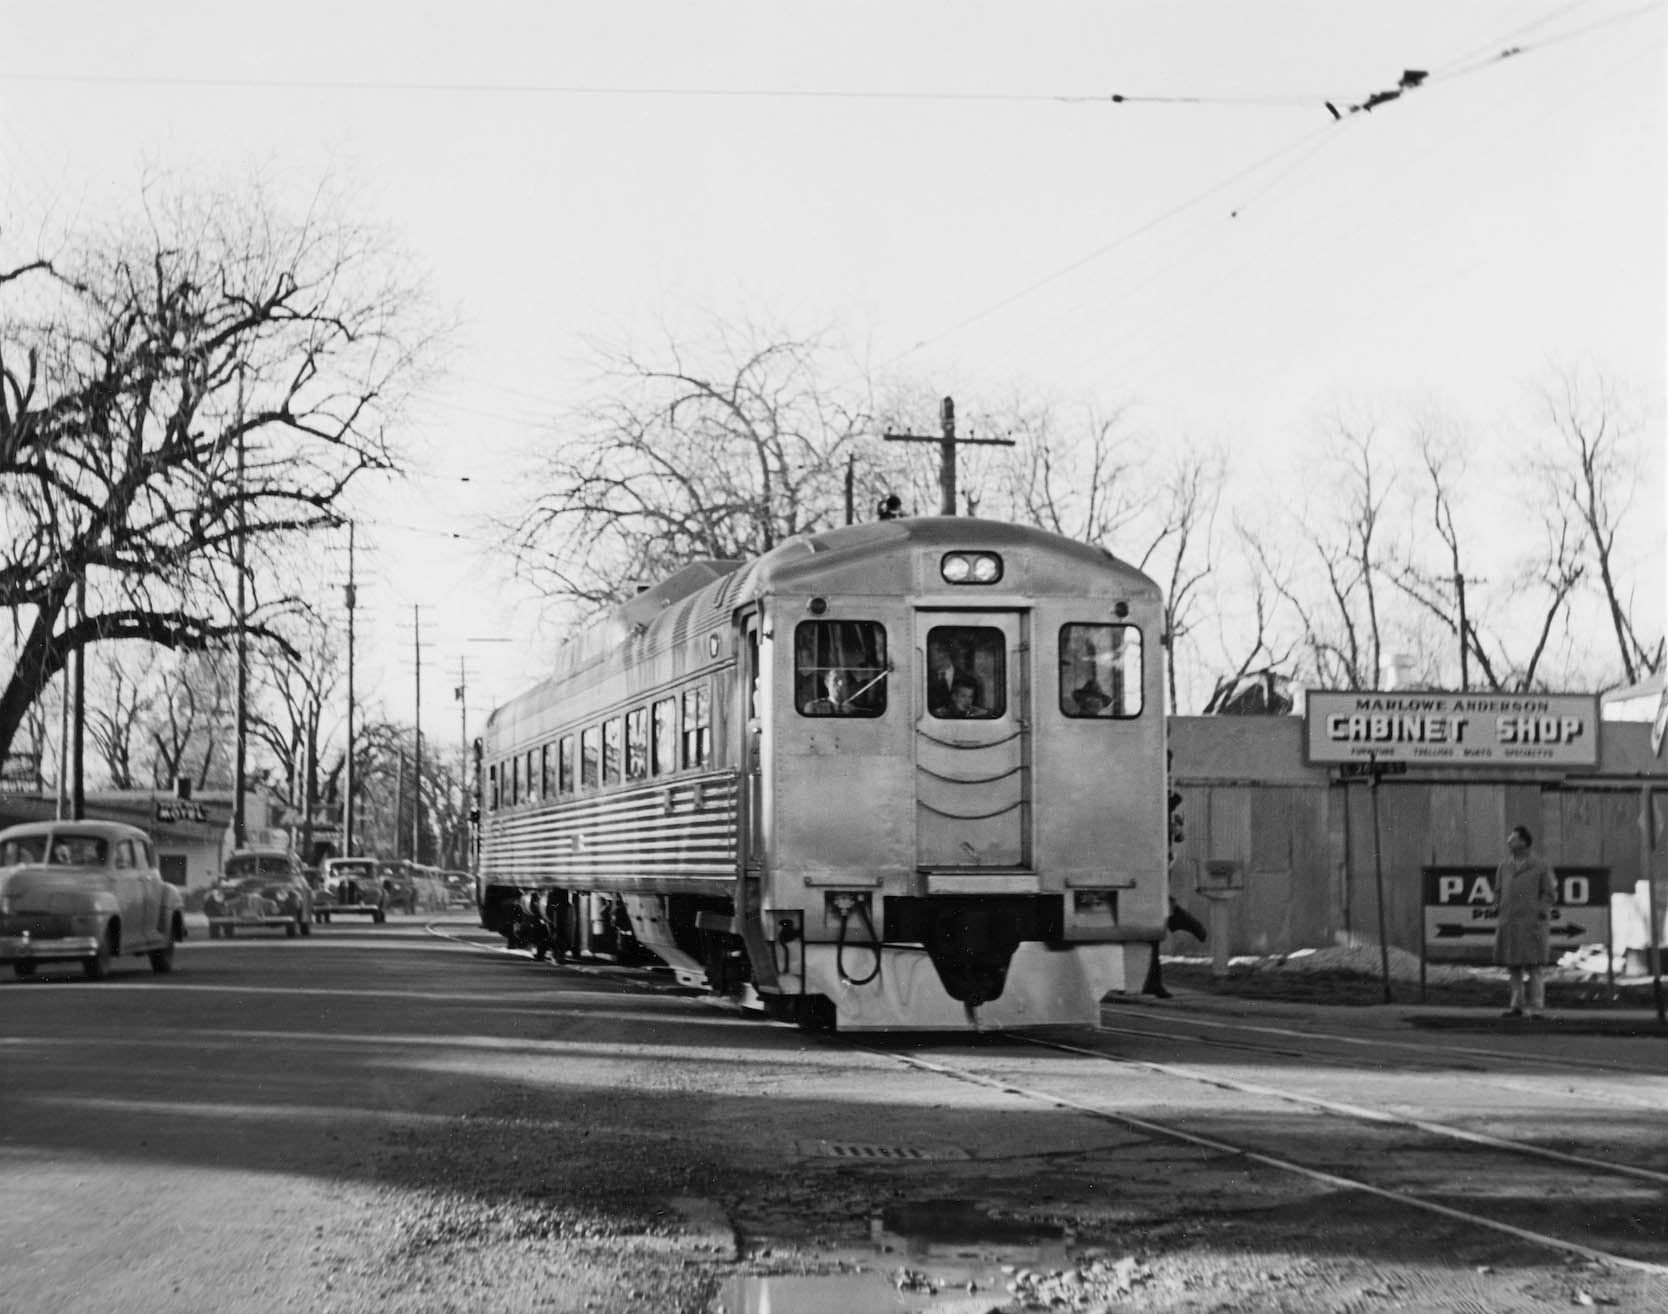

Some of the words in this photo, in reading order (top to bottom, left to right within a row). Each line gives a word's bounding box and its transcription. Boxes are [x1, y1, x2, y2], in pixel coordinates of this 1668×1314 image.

[1356, 699, 1447, 713] MARLOWE
[1453, 699, 1549, 713] ANDERSON
[1326, 713, 1469, 743] CABINET
[1496, 713, 1584, 744] SHOP
[1439, 876, 1590, 904] PAO
